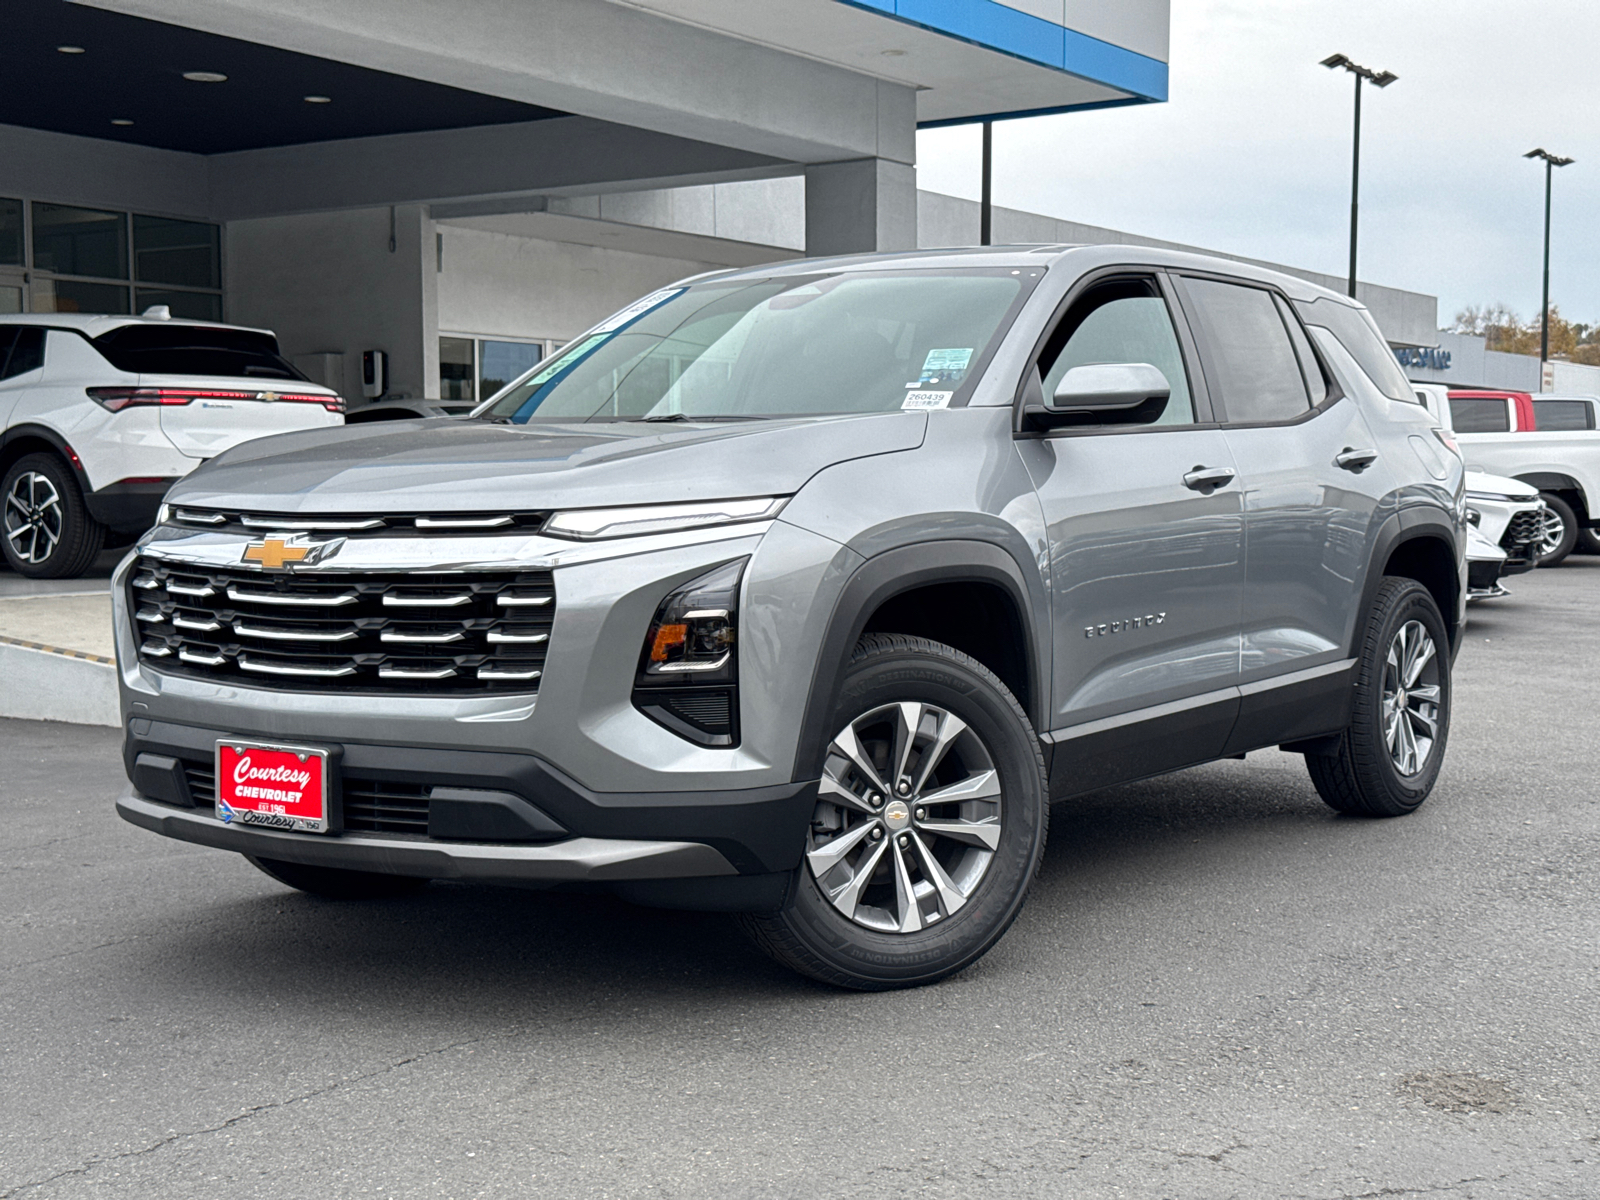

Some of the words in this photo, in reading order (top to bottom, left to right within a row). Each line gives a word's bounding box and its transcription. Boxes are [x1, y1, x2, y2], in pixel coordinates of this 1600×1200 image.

[908, 393, 945, 401] 260439
[878, 670, 951, 685] DESTINATION
[233, 756, 311, 790] Courtesy
[235, 785, 303, 803] CHEVROLET
[243, 810, 297, 832] Courtesy
[865, 949, 941, 965] DESTINATION
